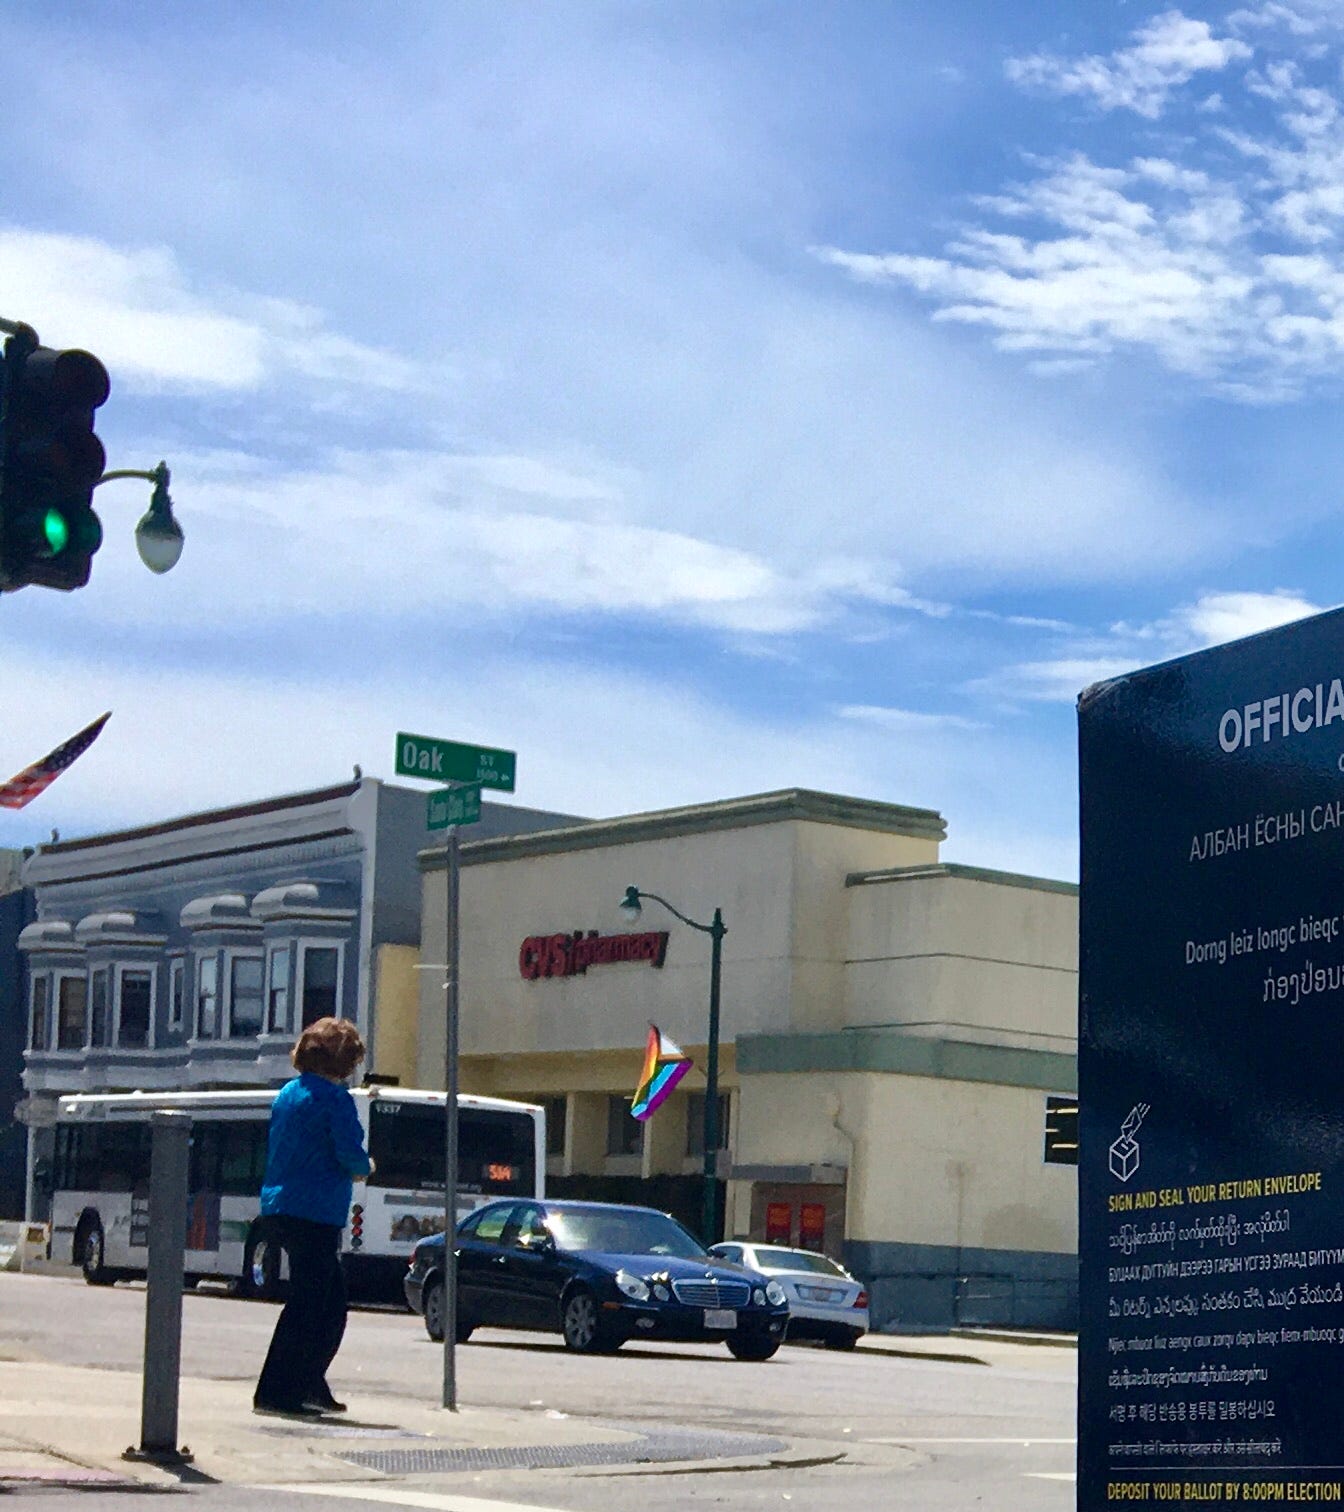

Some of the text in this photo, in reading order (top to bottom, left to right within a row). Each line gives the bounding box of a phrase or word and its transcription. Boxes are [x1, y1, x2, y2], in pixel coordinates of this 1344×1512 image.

[403, 741, 444, 772] Oak
[1189, 823, 1249, 862] АЛБАН
[1255, 808, 1305, 846] ЁСНЫ
[1185, 939, 1226, 965] Dorng
[1230, 928, 1253, 956] leiz
[1257, 925, 1296, 952] longc
[1299, 914, 1339, 943] bieqc
[1108, 1172, 1321, 1212] SIGN AND SEAL YOUR RETURN ENVELOPE
[1108, 1482, 1150, 1500] DEPOSIT
[1152, 1482, 1181, 1499] YOUR
[1184, 1482, 1223, 1500] BALLOT
[1225, 1482, 1240, 1500] BY
[1242, 1482, 1284, 1500] 8:00PM
[1287, 1482, 1341, 1500] ELECTION
